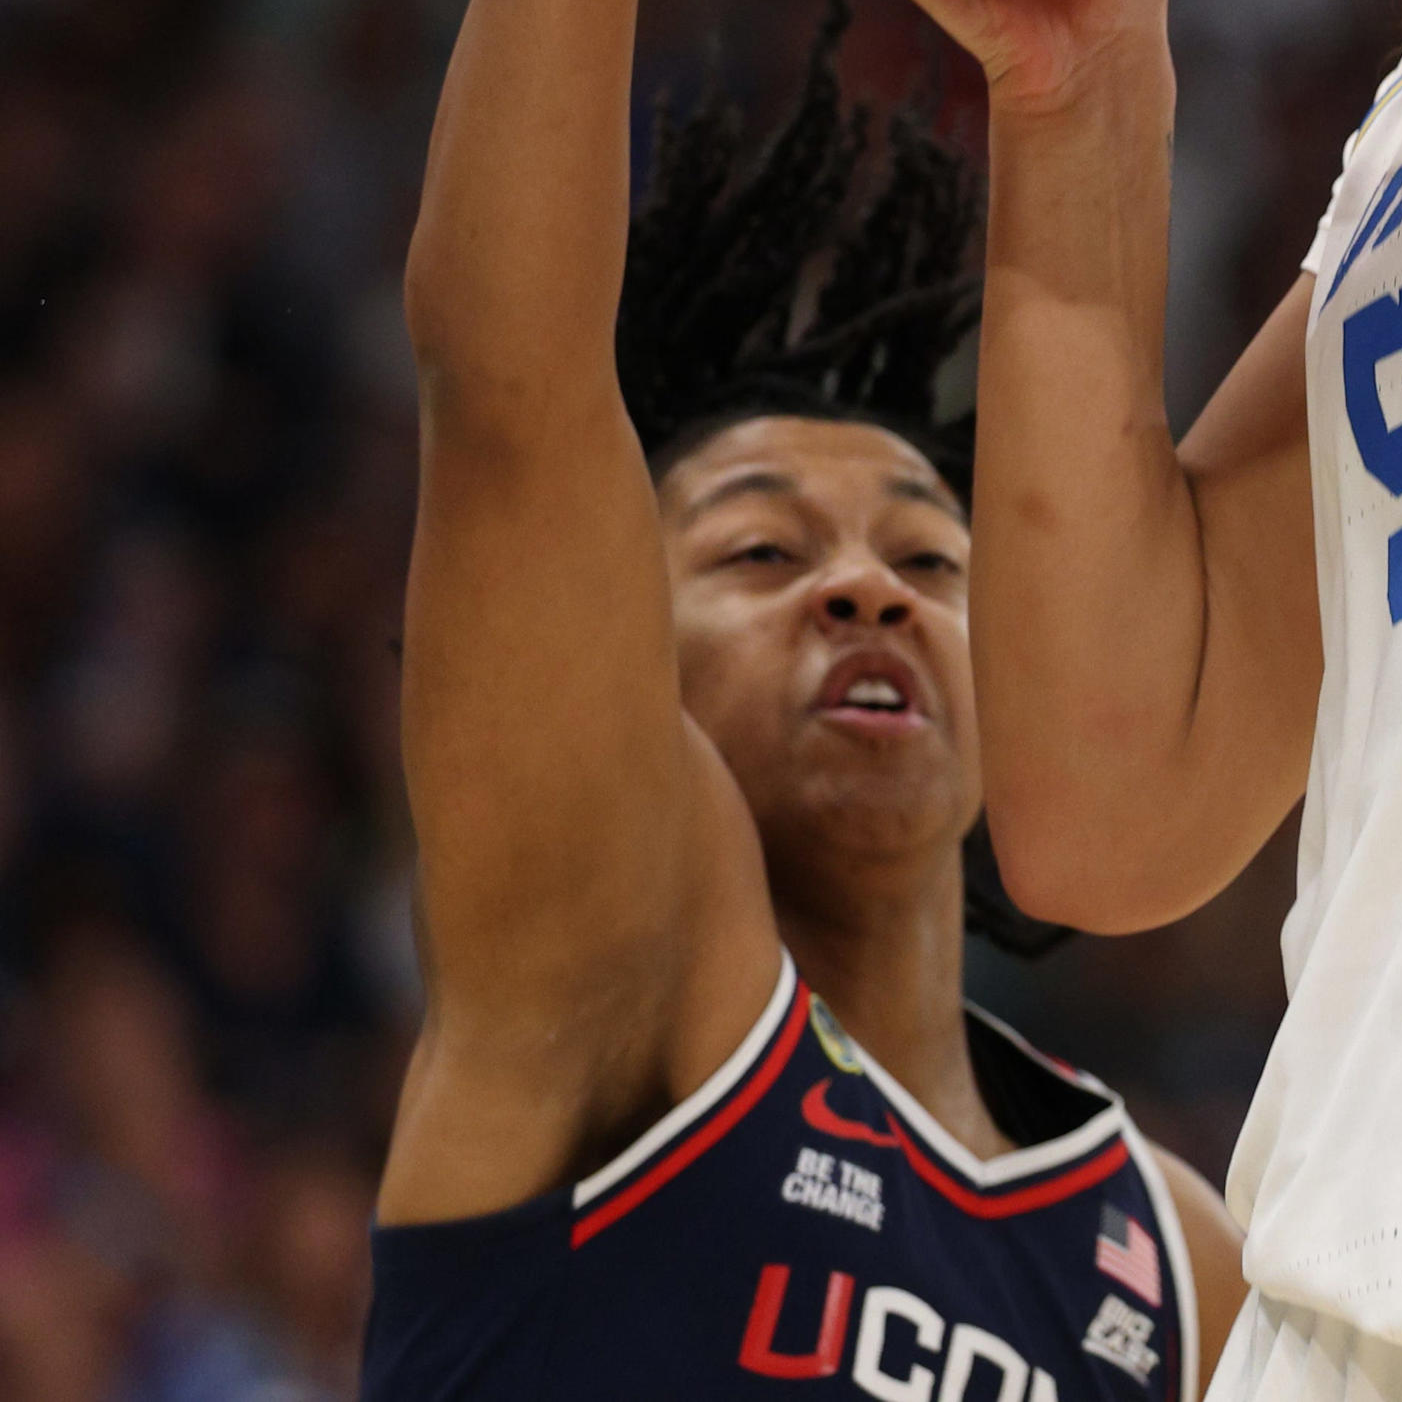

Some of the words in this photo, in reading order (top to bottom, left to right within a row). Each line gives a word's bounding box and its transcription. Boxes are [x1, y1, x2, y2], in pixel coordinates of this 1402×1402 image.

[782, 1172, 887, 1232] CHANGE
[797, 1147, 835, 1182] BE
[840, 1160, 882, 1201] THE
